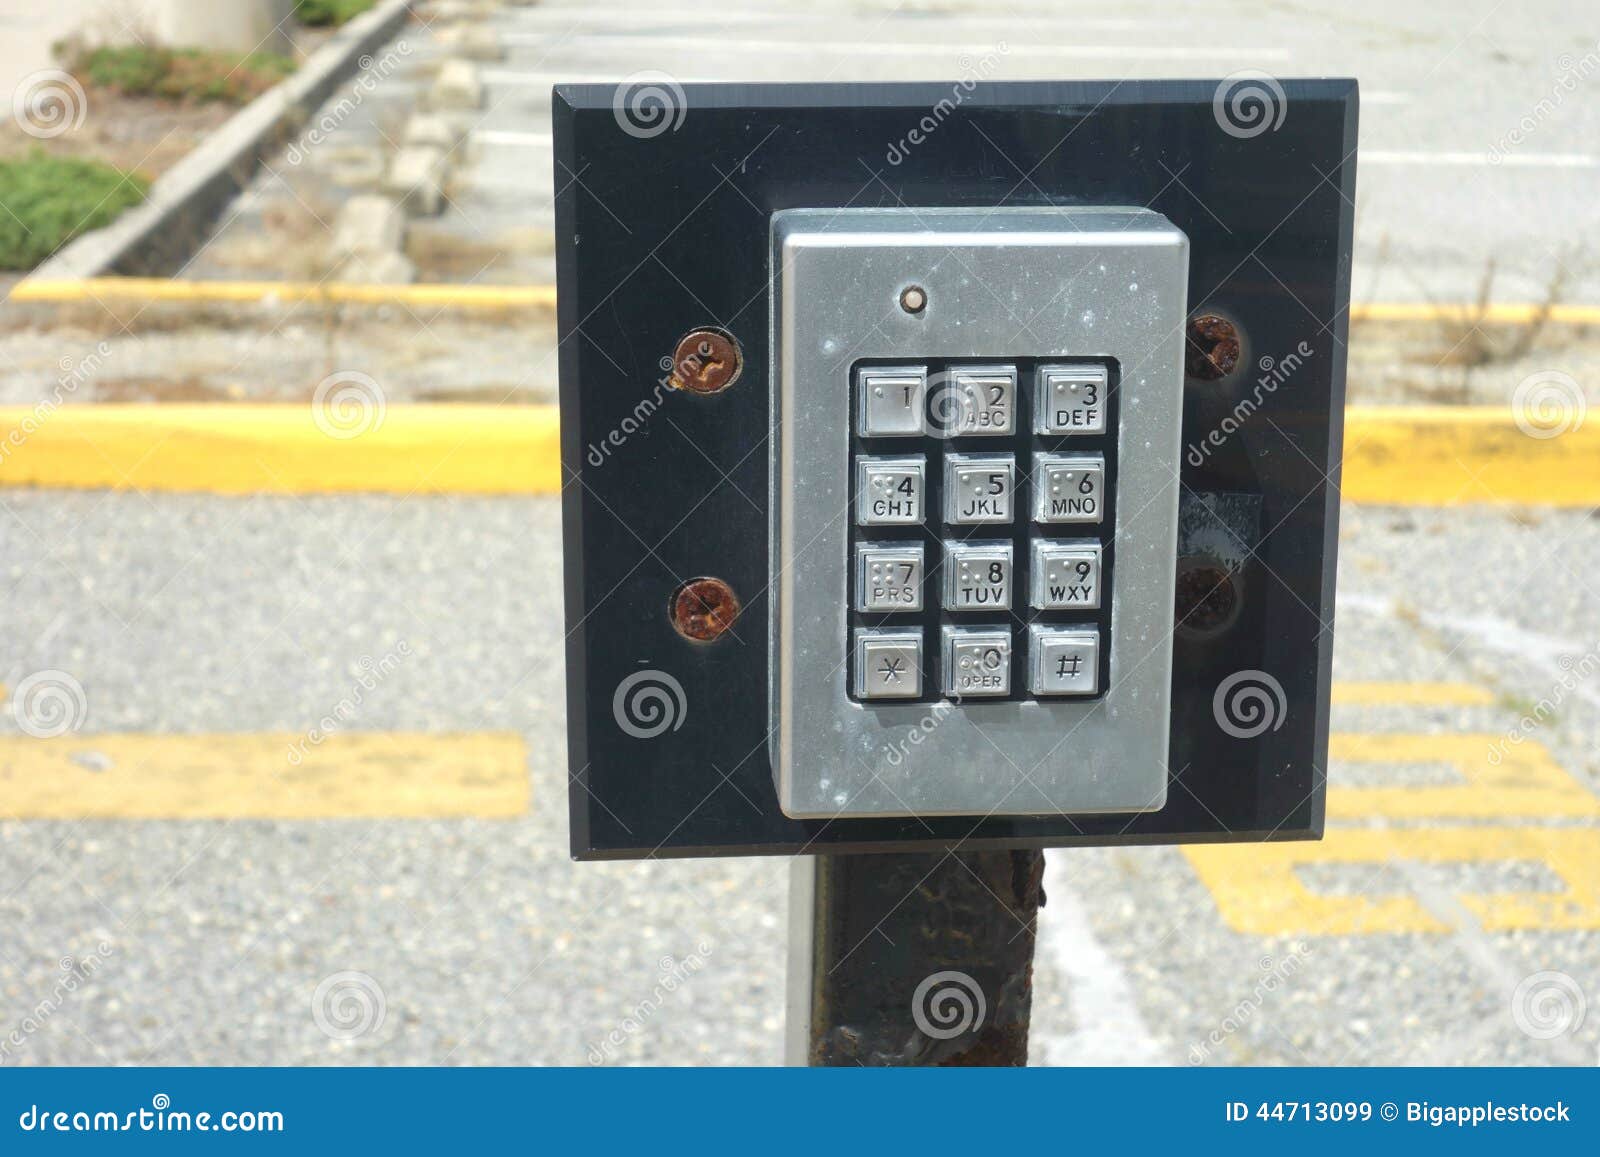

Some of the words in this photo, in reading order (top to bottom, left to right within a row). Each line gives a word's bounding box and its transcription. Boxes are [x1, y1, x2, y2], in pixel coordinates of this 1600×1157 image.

[903, 386, 911, 408] 1
[990, 386, 1005, 408] 2
[1082, 384, 1098, 406] 3
[965, 411, 1006, 427] ABC
[1056, 410, 1098, 427] DEF
[897, 477, 914, 497] 4
[988, 474, 1004, 495] 5
[1078, 473, 1094, 495] 6
[872, 500, 914, 517] GHI
[963, 500, 1004, 516] JKL
[1052, 497, 1096, 515] MNO
[898, 563, 914, 584] 7
[988, 562, 1003, 584] 8
[1075, 561, 1091, 583] 9
[872, 587, 915, 604] PRS
[962, 587, 1004, 604] TUV
[1050, 585, 1093, 602] WXY
[961, 675, 1002, 689] OPER
